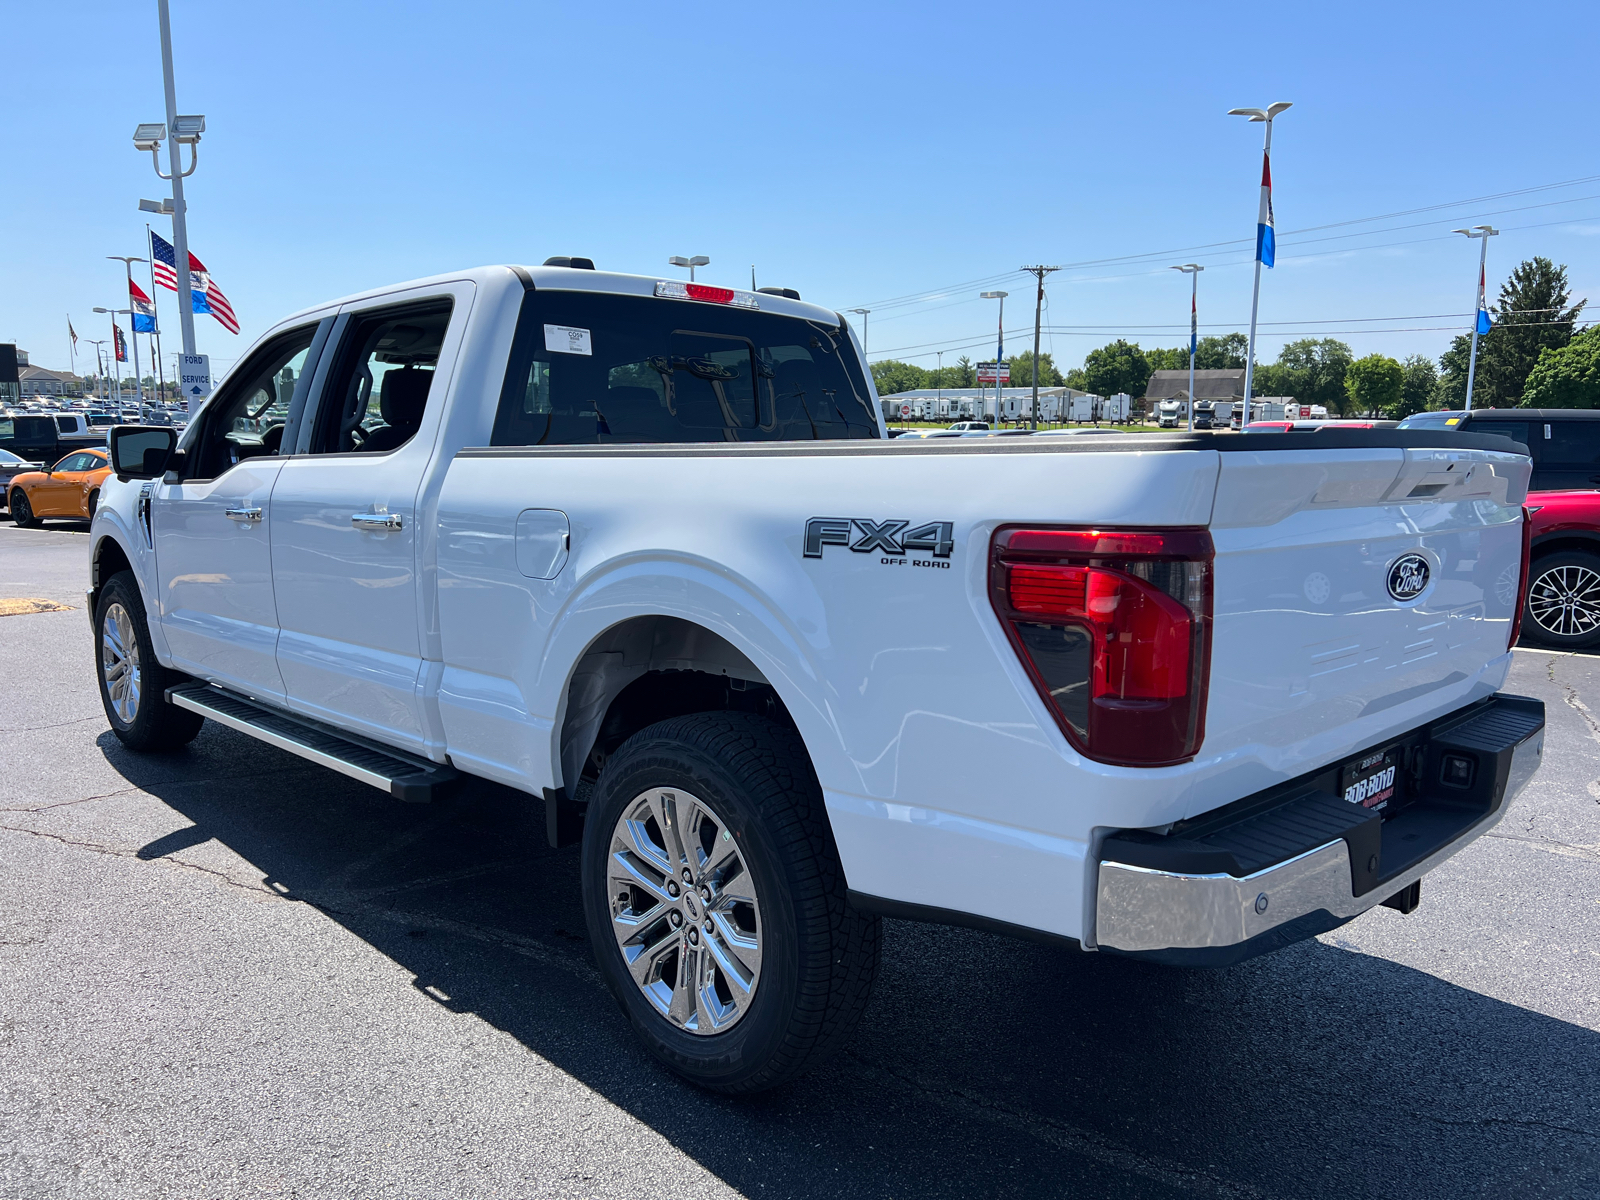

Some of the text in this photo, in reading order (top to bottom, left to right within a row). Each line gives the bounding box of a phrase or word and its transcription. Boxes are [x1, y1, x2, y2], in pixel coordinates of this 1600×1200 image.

[184, 355, 203, 365] FORD
[182, 375, 209, 384] SERVICE
[802, 516, 955, 559] FX4
[880, 557, 951, 569] OFF ROAD
[1395, 561, 1425, 593] Ford
